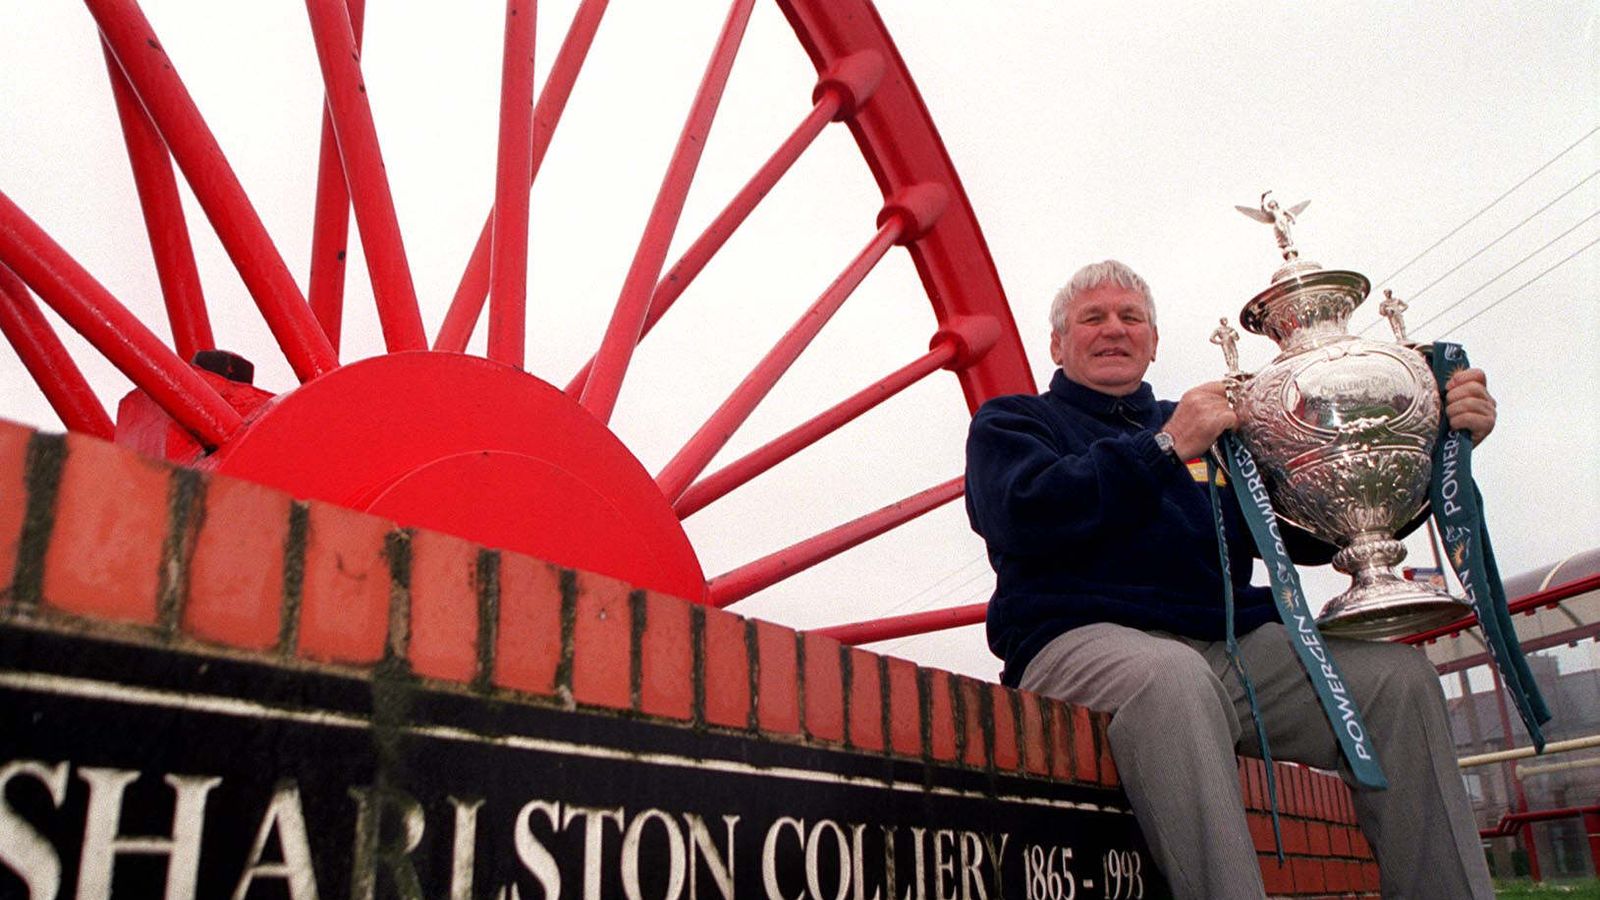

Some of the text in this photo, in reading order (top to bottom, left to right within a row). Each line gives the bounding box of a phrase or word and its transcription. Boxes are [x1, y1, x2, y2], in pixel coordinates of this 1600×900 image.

[1293, 614, 1371, 761] POWERGEN
[0, 760, 738, 900] SHARLSTON
[762, 816, 1008, 900] COLLIERY
[1023, 844, 1076, 900] 1865
[1103, 848, 1144, 900] 1993
